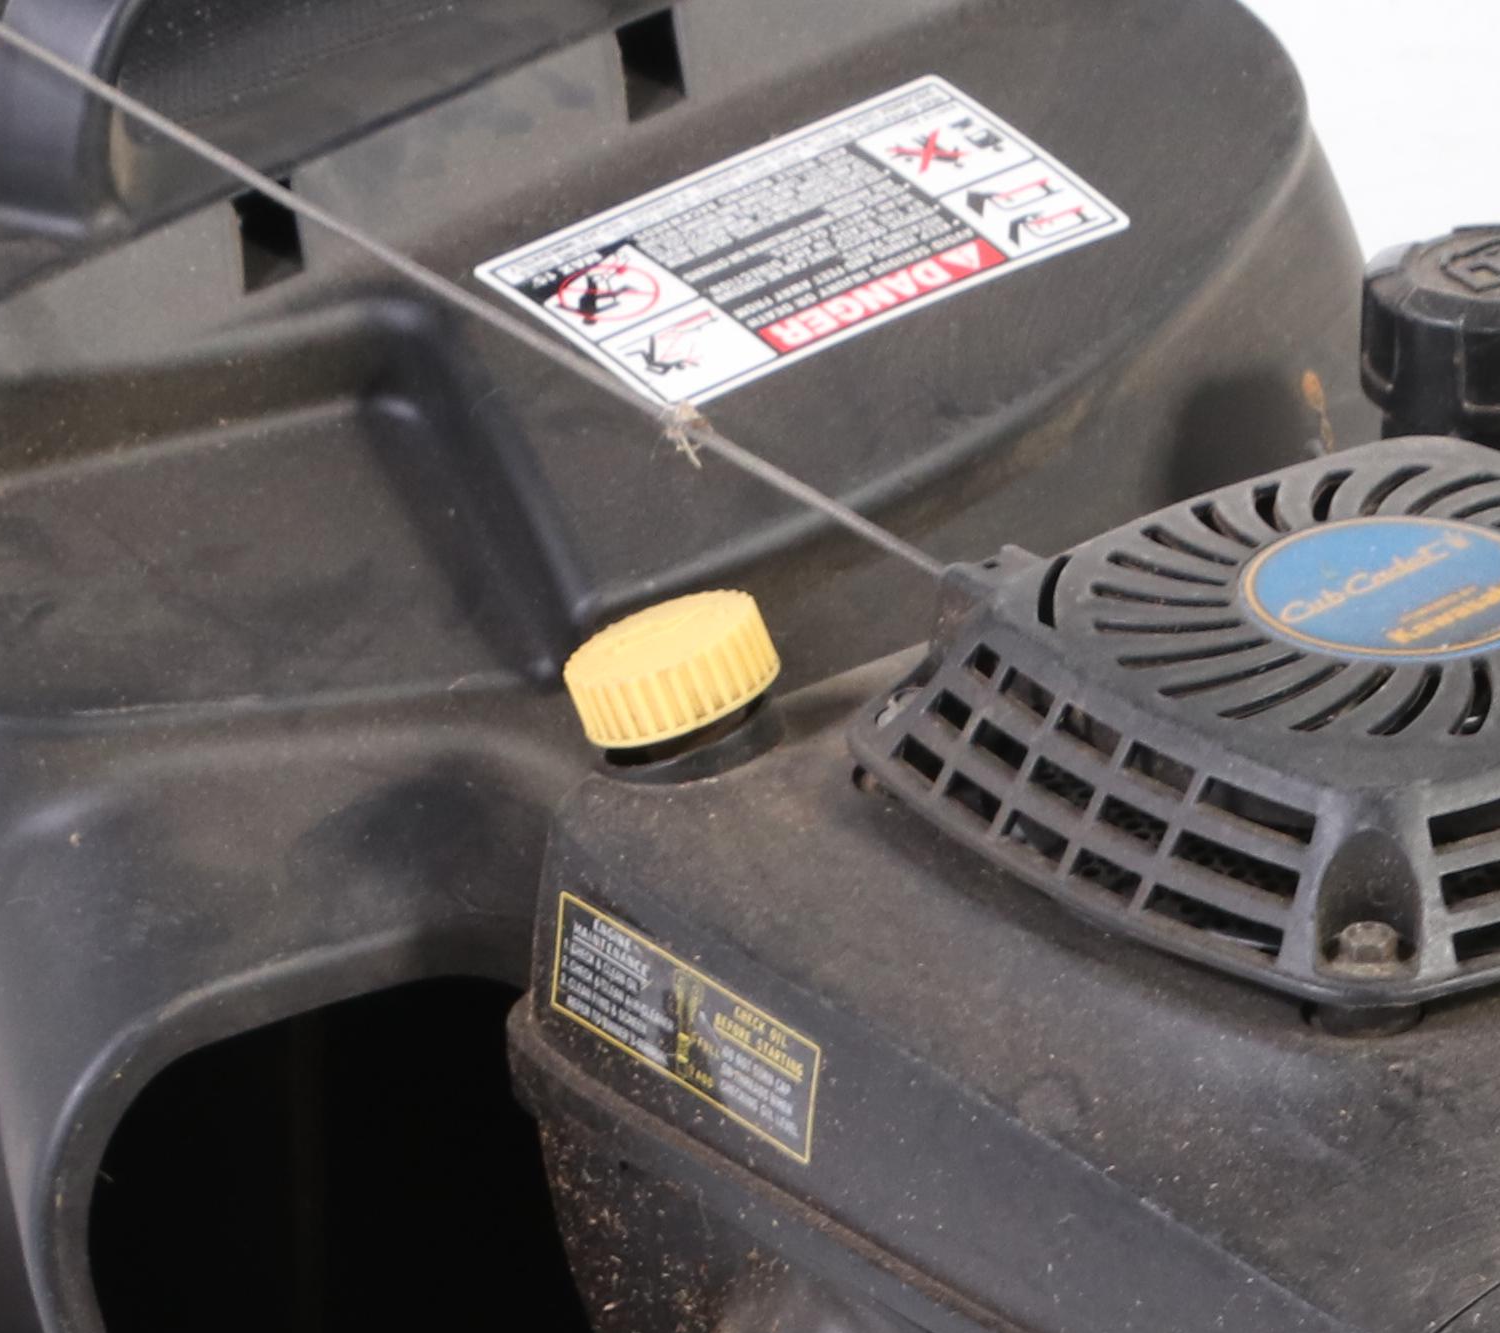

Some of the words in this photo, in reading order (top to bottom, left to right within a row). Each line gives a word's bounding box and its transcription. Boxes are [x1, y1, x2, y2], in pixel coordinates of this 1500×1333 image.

[762, 258, 957, 346] DANGER
[572, 919, 650, 979] MAINTENANCE
[714, 1009, 750, 1046] BEFORE
[755, 1035, 804, 1079] STARTING
[734, 1004, 766, 1036] CHECK
[768, 1025, 789, 1050] OIL
